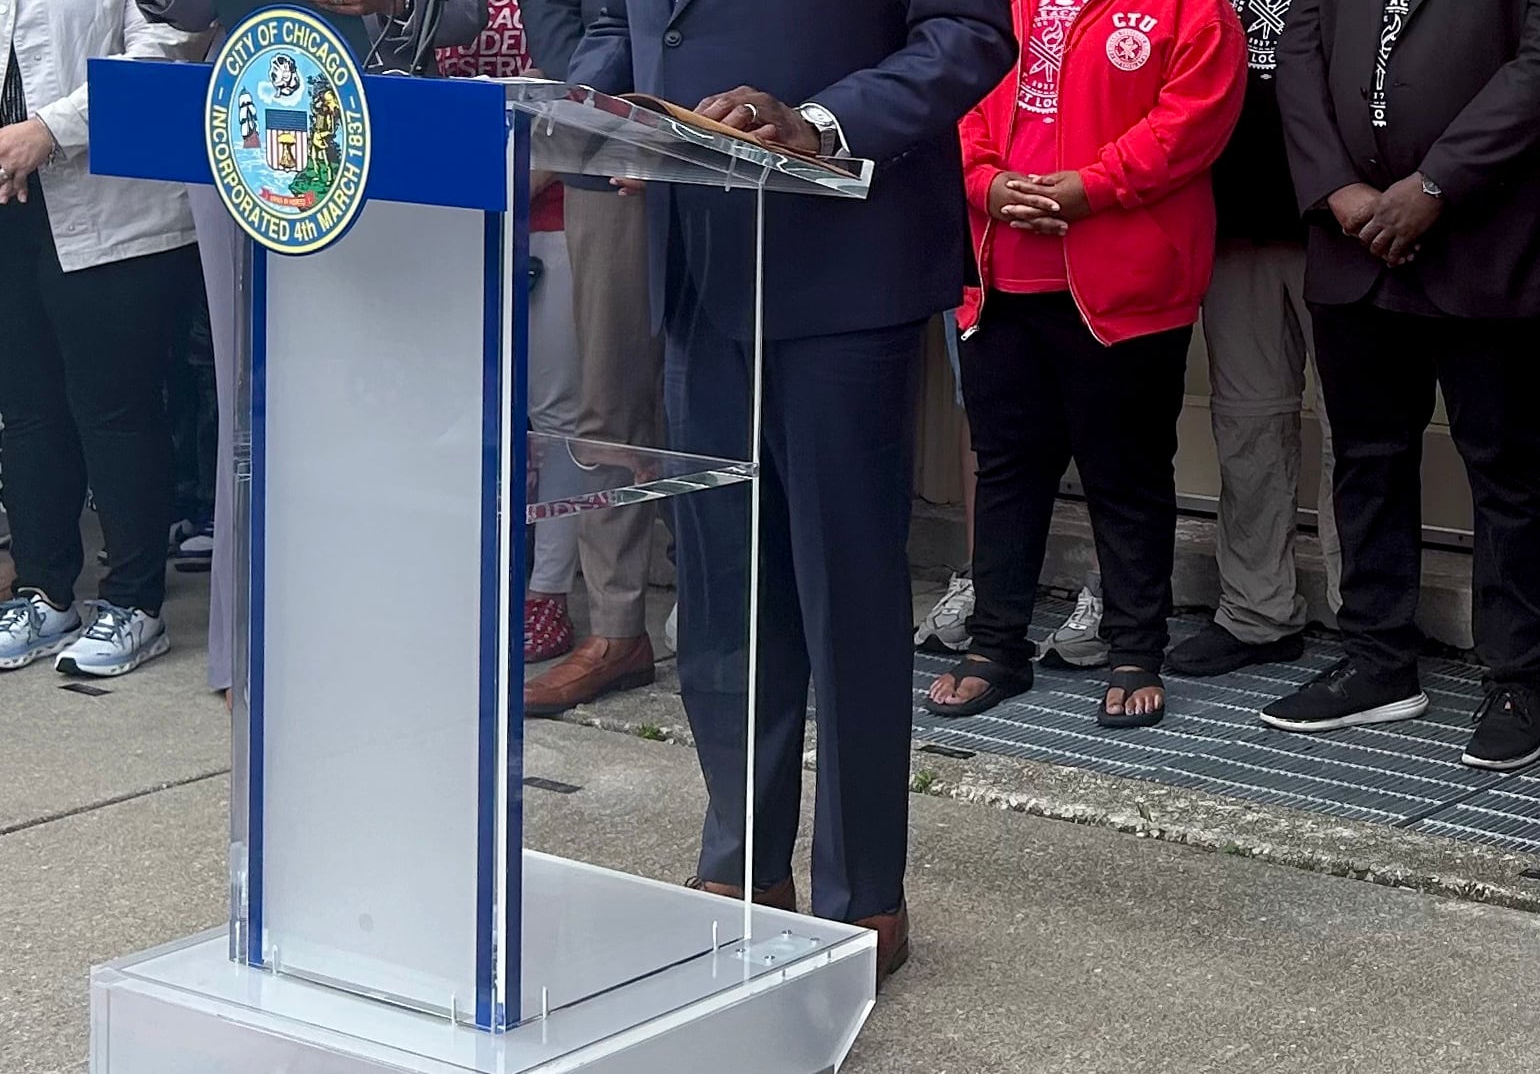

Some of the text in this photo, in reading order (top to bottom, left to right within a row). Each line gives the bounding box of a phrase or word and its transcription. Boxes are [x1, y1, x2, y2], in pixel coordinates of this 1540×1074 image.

[1112, 12, 1158, 33] CTU
[226, 21, 349, 86] CITY OF CHICAGO
[438, 56, 533, 77] ESERV
[212, 105, 364, 242] INCORPORATED 4th MARCH 1837
